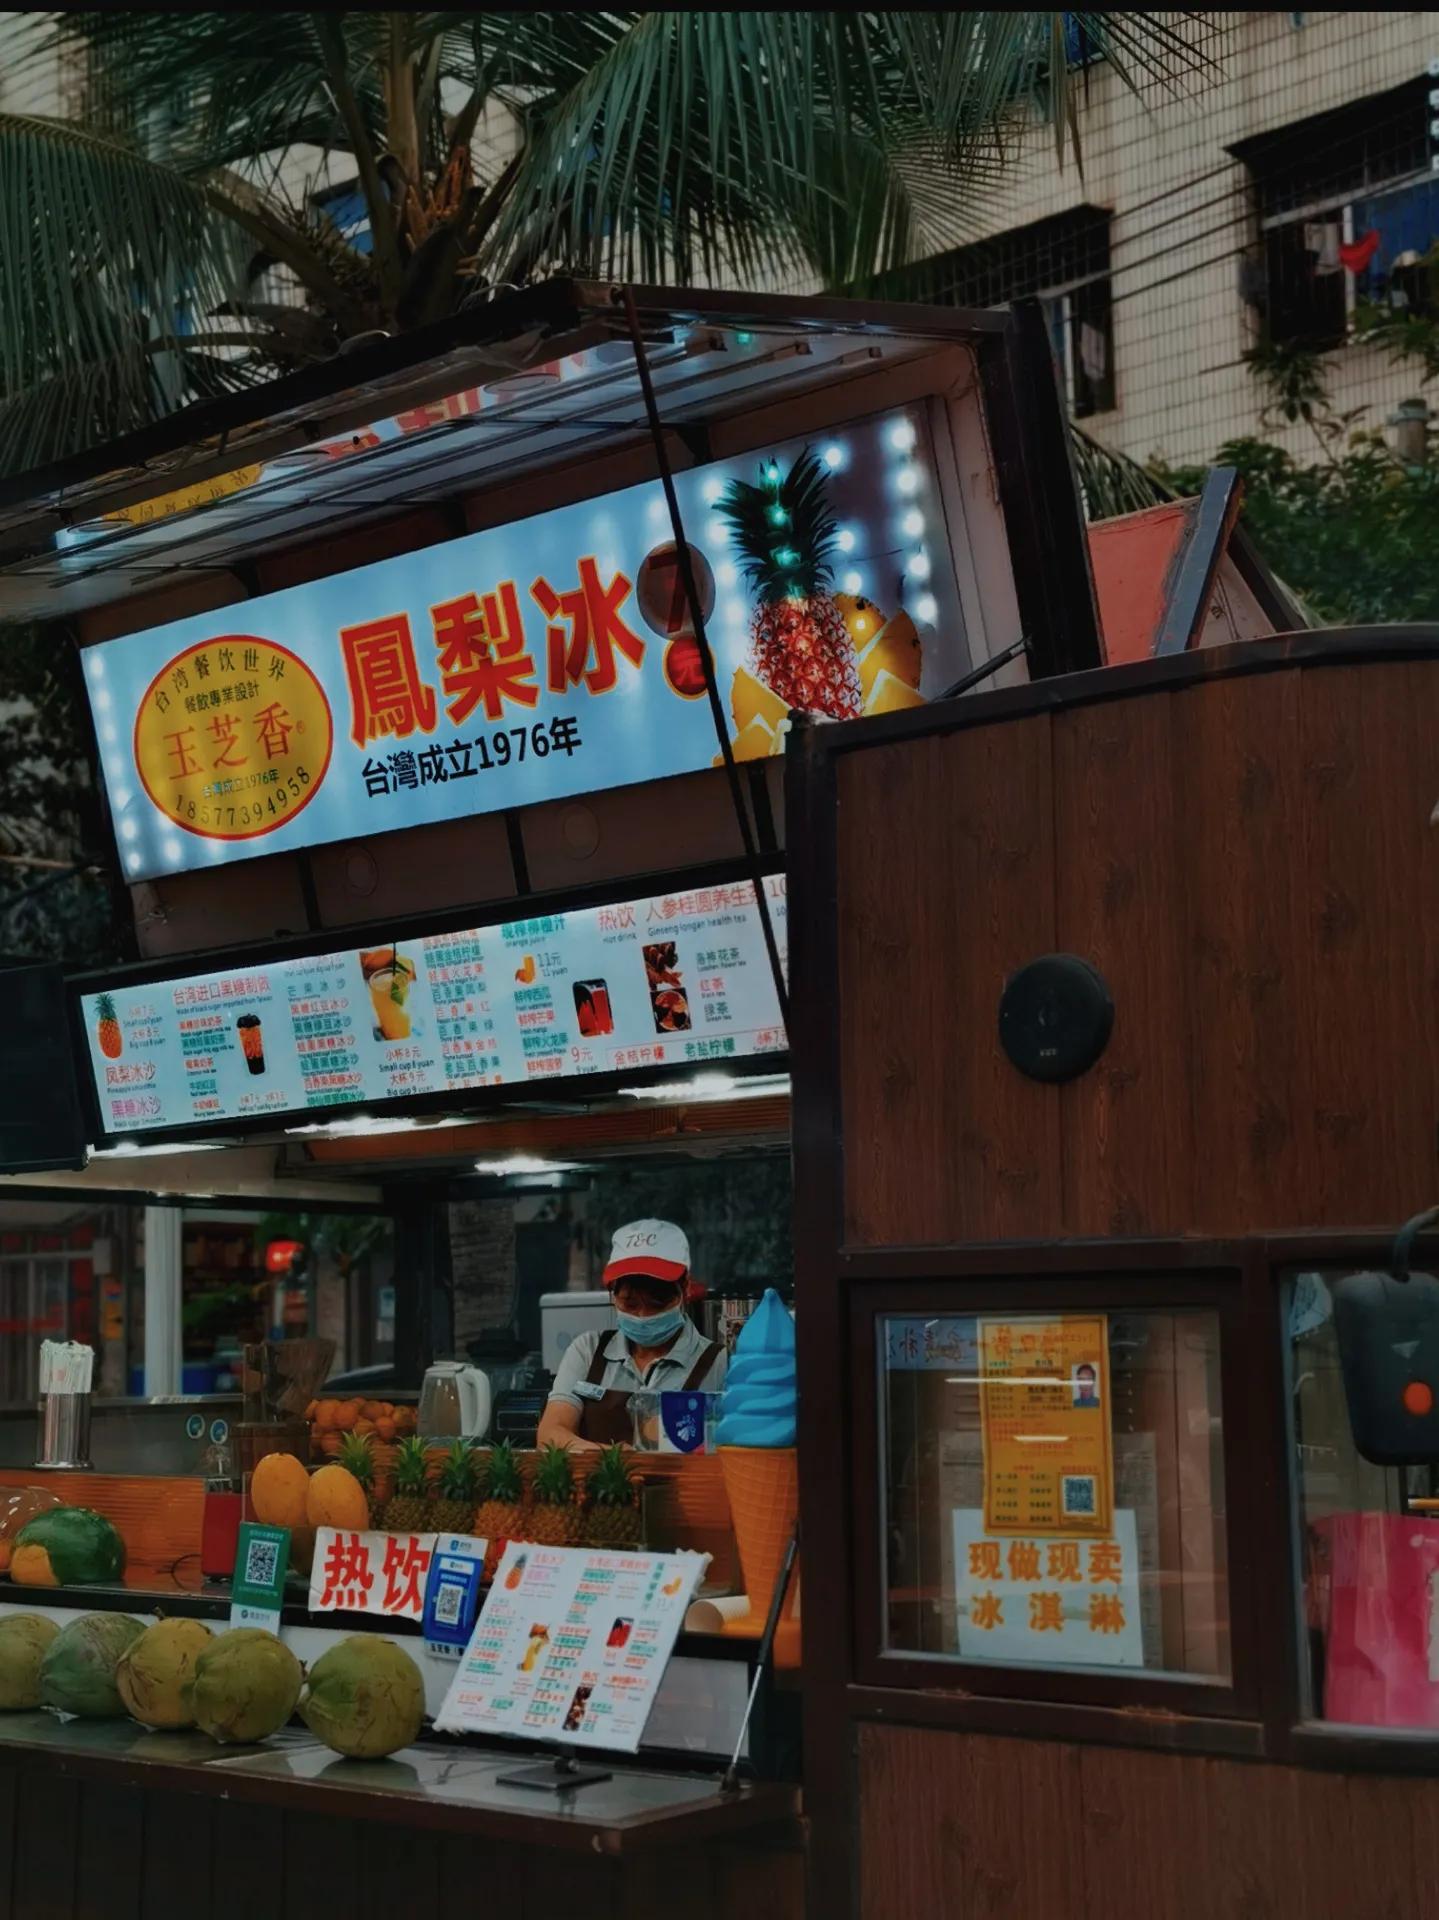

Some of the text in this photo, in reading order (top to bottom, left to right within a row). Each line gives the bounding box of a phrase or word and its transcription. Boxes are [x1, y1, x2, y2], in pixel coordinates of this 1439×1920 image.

[155, 648, 286, 714] 台湾餐饮世界
[340, 555, 646, 750] 鳳梨冰
[163, 701, 294, 781] 玉芝香
[361, 716, 583, 797] 台灣成立1976年
[598, 906, 635, 930] 热饮
[320, 1533, 430, 1613] 热饮
[968, 1541, 1122, 1583] 现做现卖
[971, 1590, 1126, 1634] 冰淇淋
